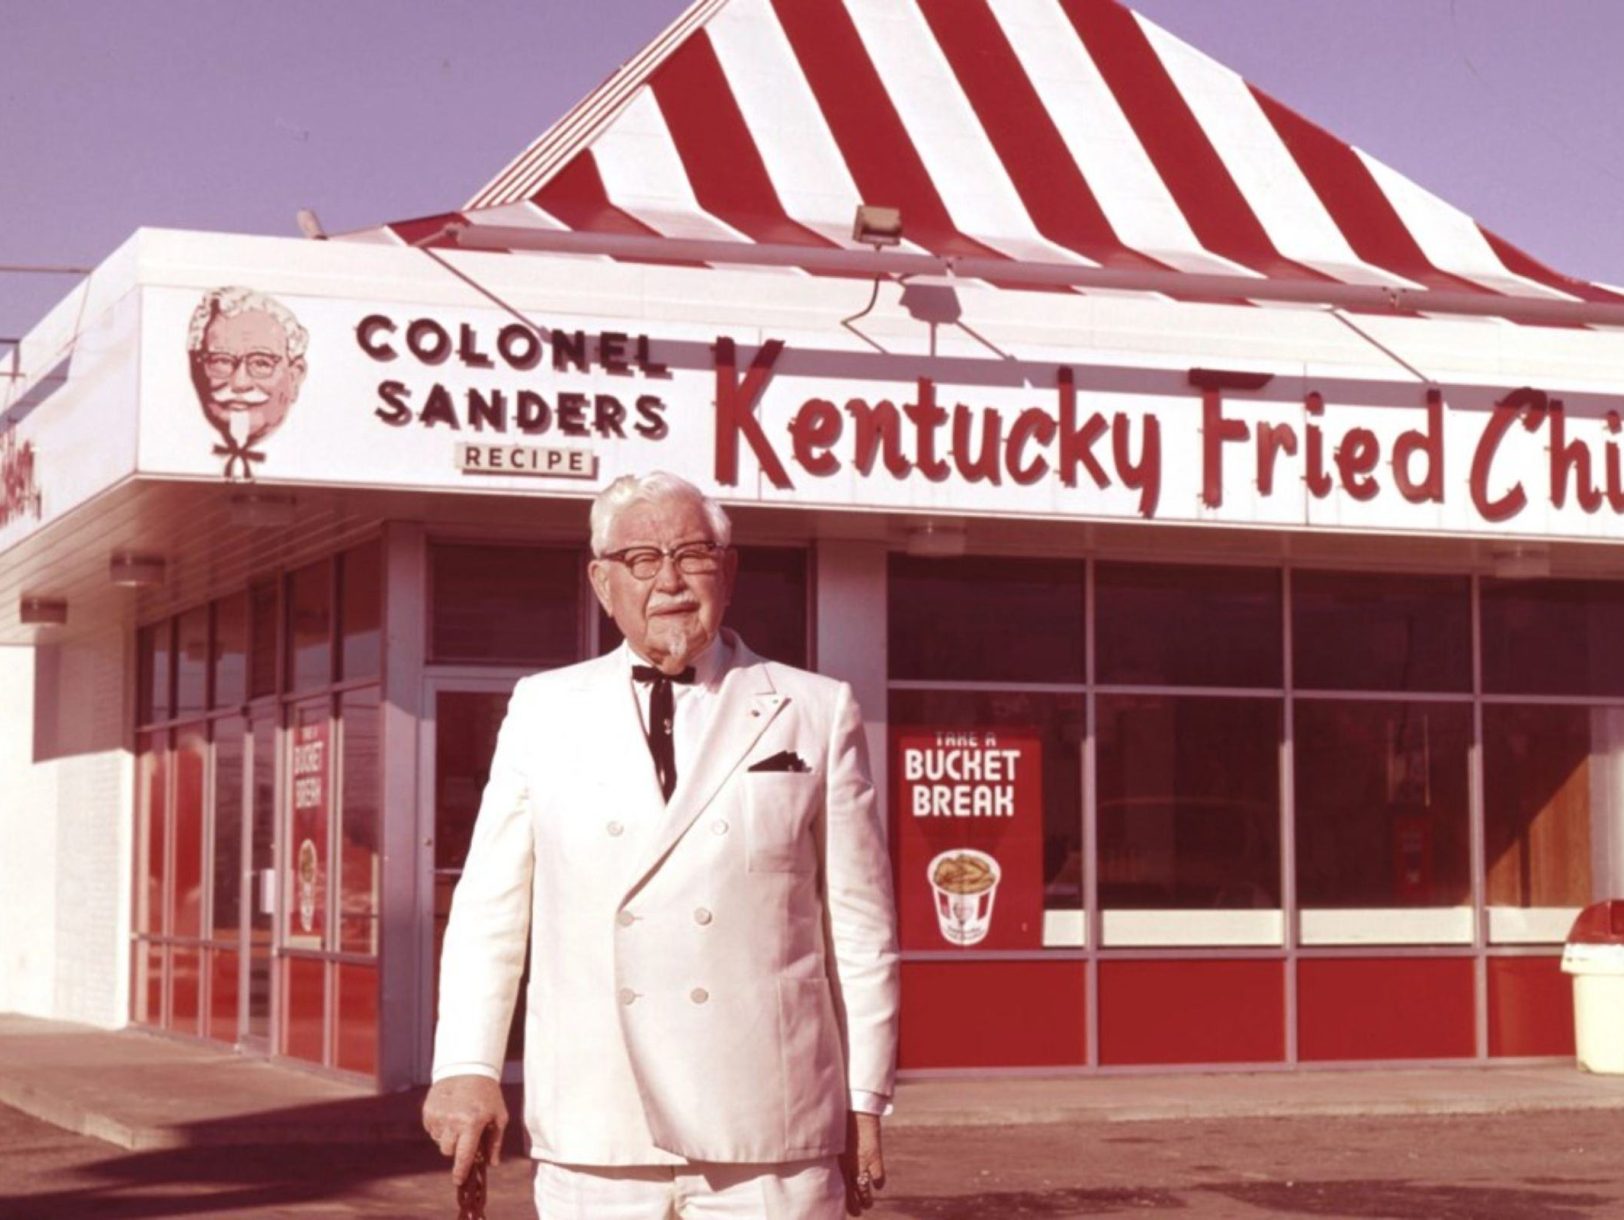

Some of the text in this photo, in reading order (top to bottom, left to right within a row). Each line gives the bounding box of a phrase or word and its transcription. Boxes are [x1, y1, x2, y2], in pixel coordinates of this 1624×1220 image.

[355, 314, 673, 379] COLONEL
[375, 380, 668, 440] SANDERS
[713, 336, 1624, 522] Kentucky Fried Chi
[465, 446, 584, 472] RECIPE
[905, 749, 1021, 781] BUCKET
[912, 785, 1014, 817] BREAK
